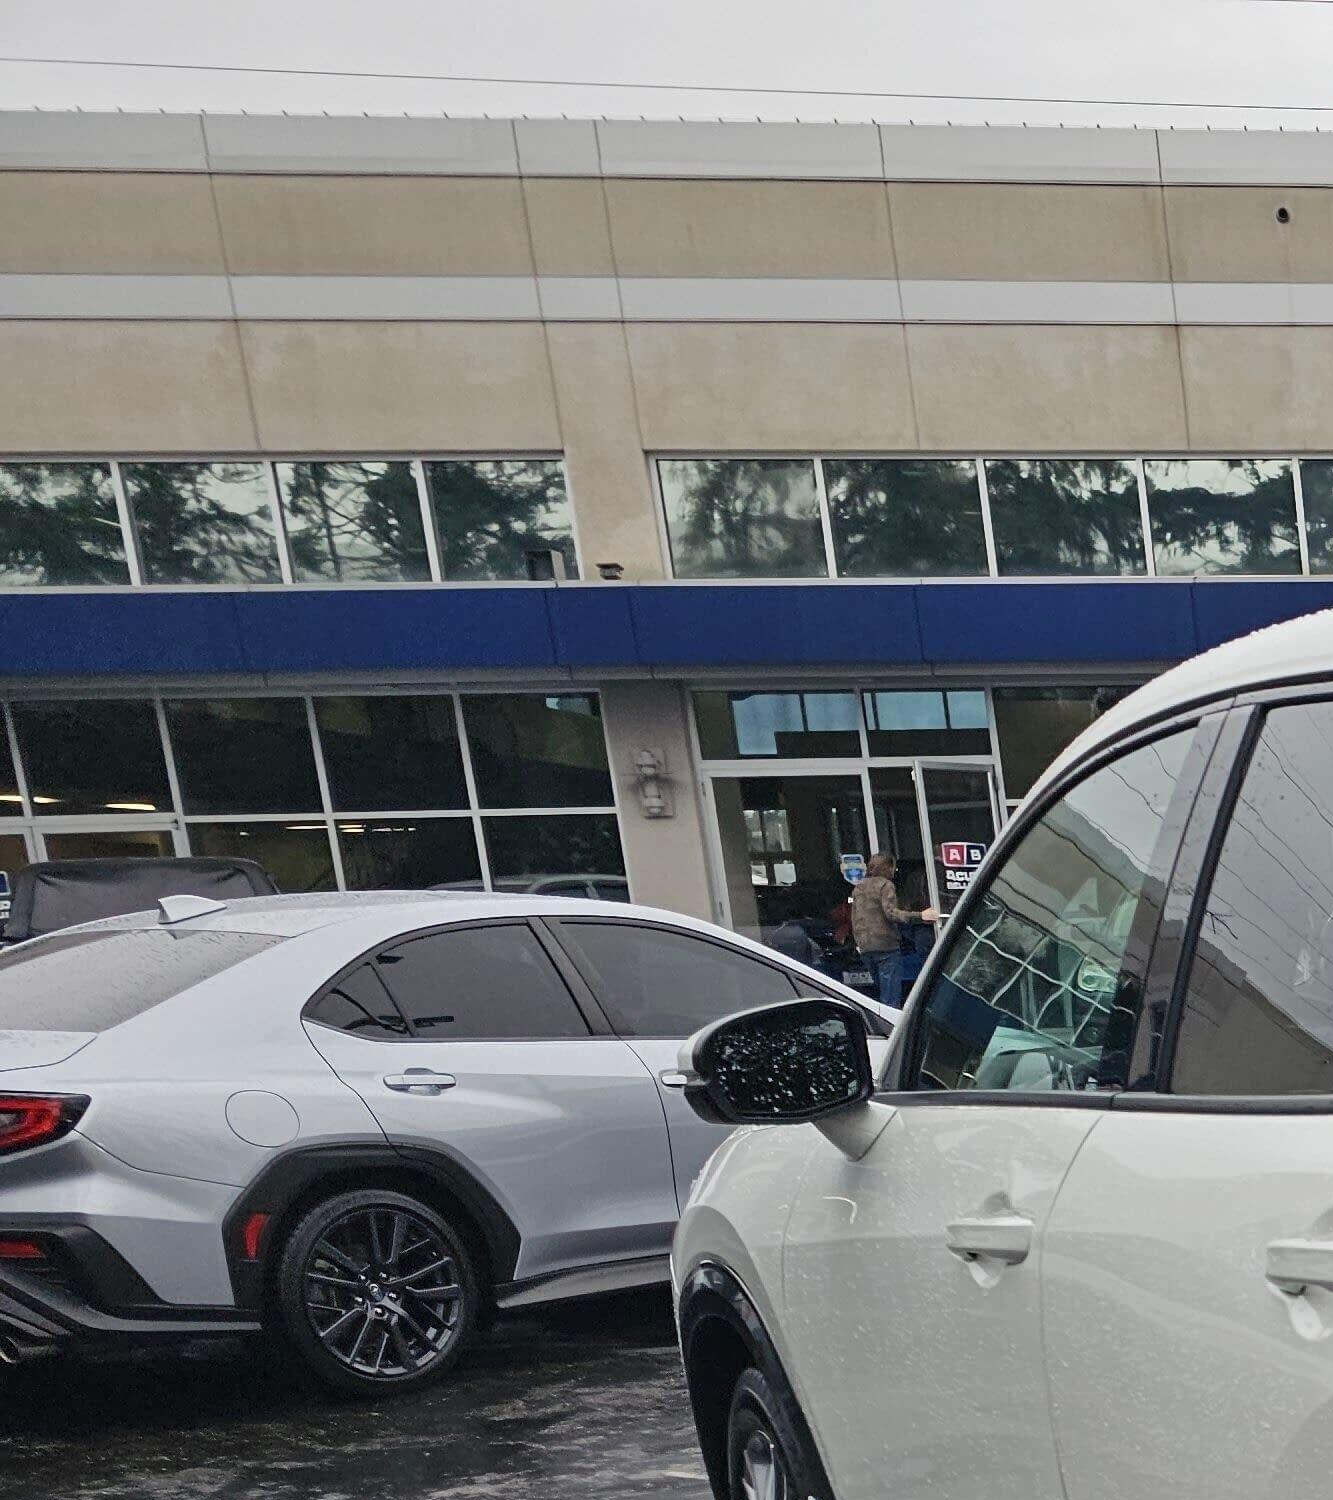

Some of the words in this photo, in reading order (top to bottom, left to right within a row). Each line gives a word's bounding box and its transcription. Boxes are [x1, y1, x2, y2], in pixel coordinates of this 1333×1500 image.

[949, 848, 961, 861] A
[969, 849, 982, 861] B
[946, 870, 975, 881] ACU
